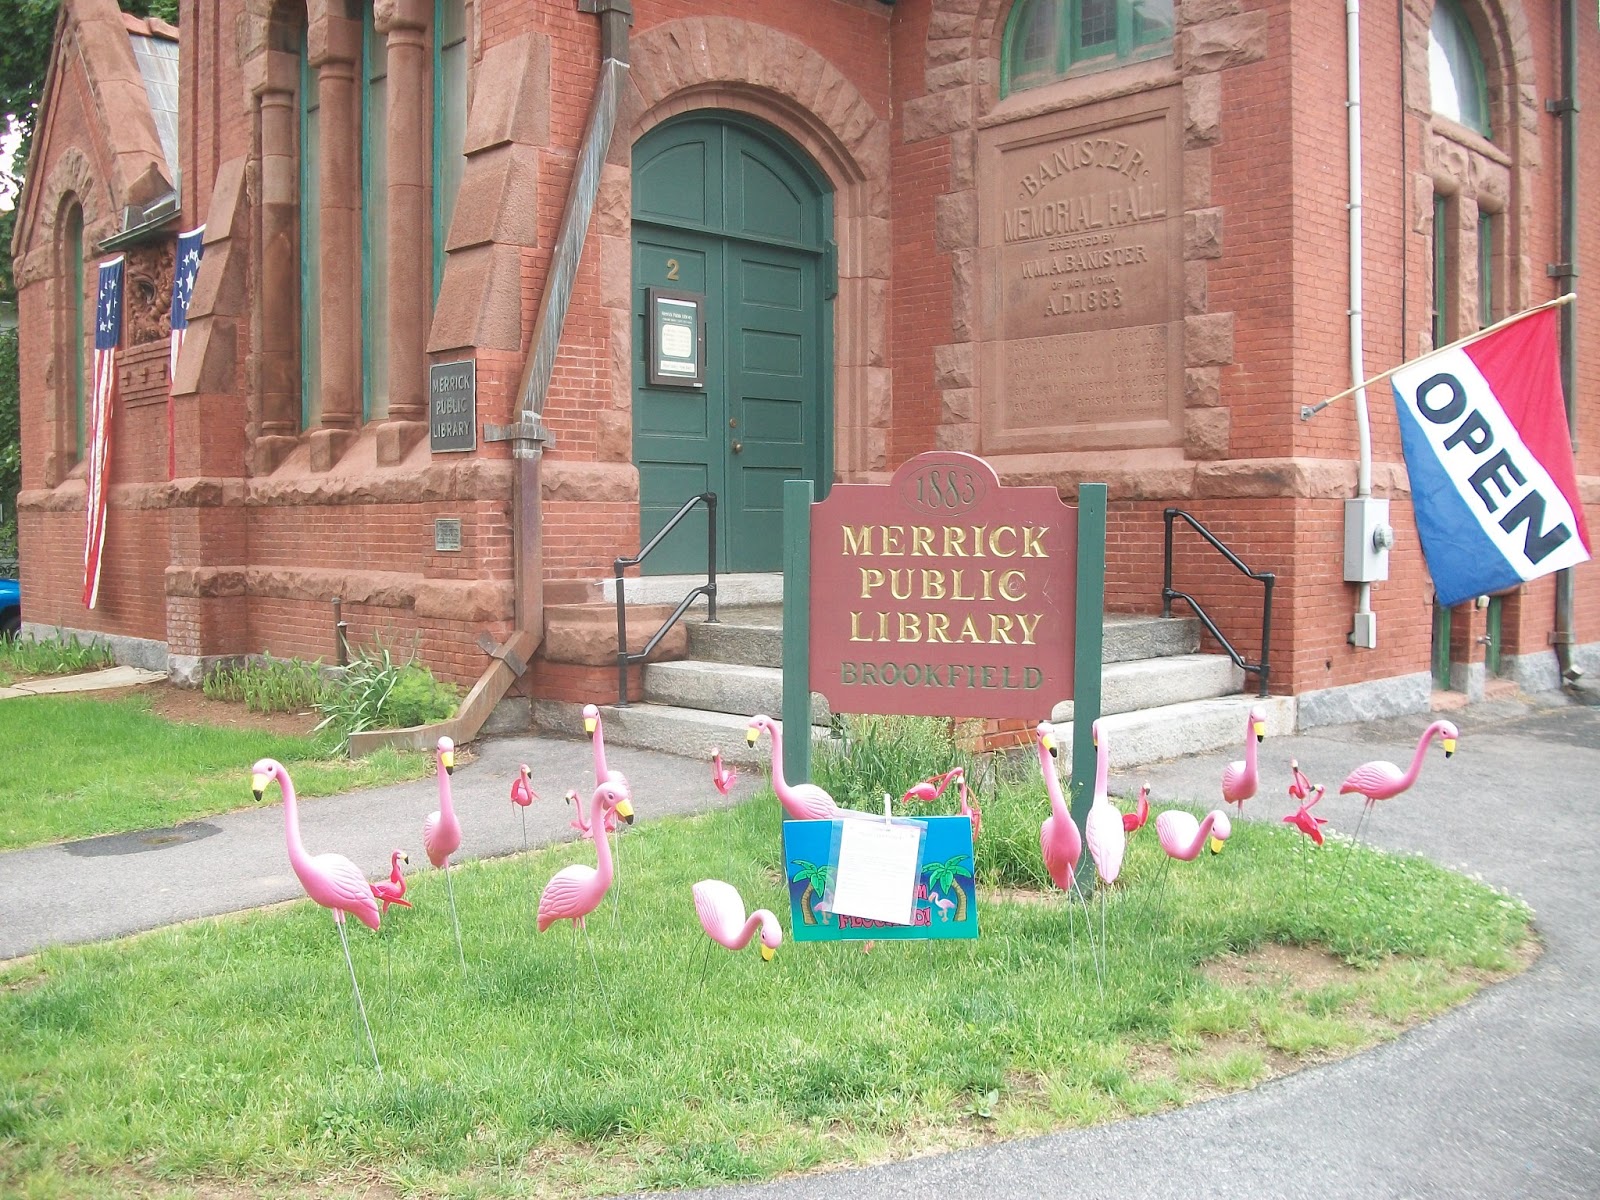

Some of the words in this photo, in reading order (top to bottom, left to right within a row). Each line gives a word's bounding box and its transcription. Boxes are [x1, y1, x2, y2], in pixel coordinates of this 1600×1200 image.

[1004, 193, 1103, 243] MEMORIAL
[1108, 182, 1167, 226] HALL
[1048, 237, 1098, 252] ERECTED
[1101, 233, 1117, 246] BY
[666, 258, 680, 281] 2
[1051, 282, 1062, 291] OF
[1067, 278, 1085, 289] NEW
[1090, 274, 1115, 286] YORK
[432, 374, 470, 394] MERRICK
[436, 397, 468, 415] PUBLIC
[433, 419, 471, 439] LIBRARY
[1416, 372, 1572, 565] OPEN
[916, 470, 975, 509] 1883
[841, 523, 1050, 558] MERRICK
[859, 566, 1028, 602] PUBLIC
[849, 611, 1044, 645] LIBRARY
[840, 661, 1043, 691] BROOKFIELD
